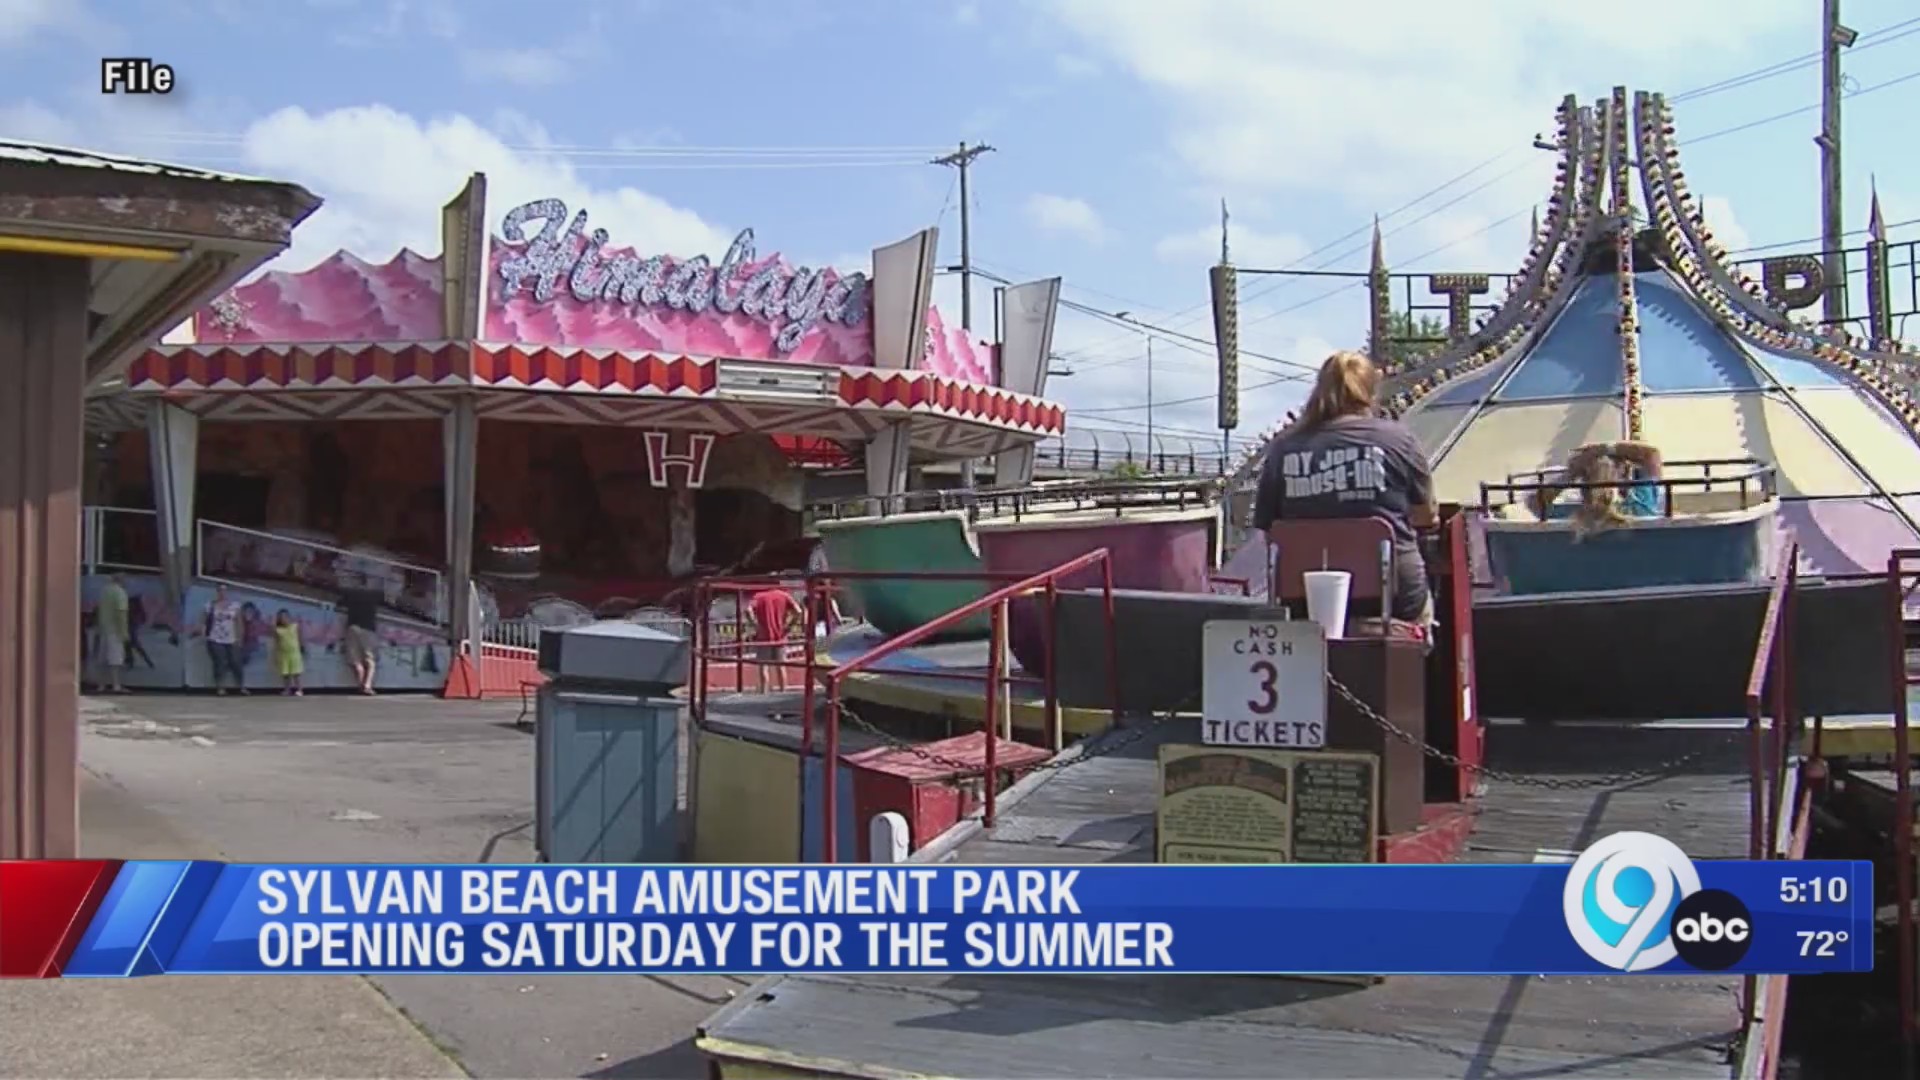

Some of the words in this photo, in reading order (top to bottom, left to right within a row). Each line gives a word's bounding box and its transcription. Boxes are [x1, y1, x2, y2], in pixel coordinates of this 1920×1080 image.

[500, 198, 867, 353] Himalaya
[643, 431, 715, 488] H
[1233, 640, 1293, 656] CASH
[1249, 624, 1279, 639] NO
[1248, 660, 1279, 714] 3
[1206, 719, 1322, 745] TICKETS
